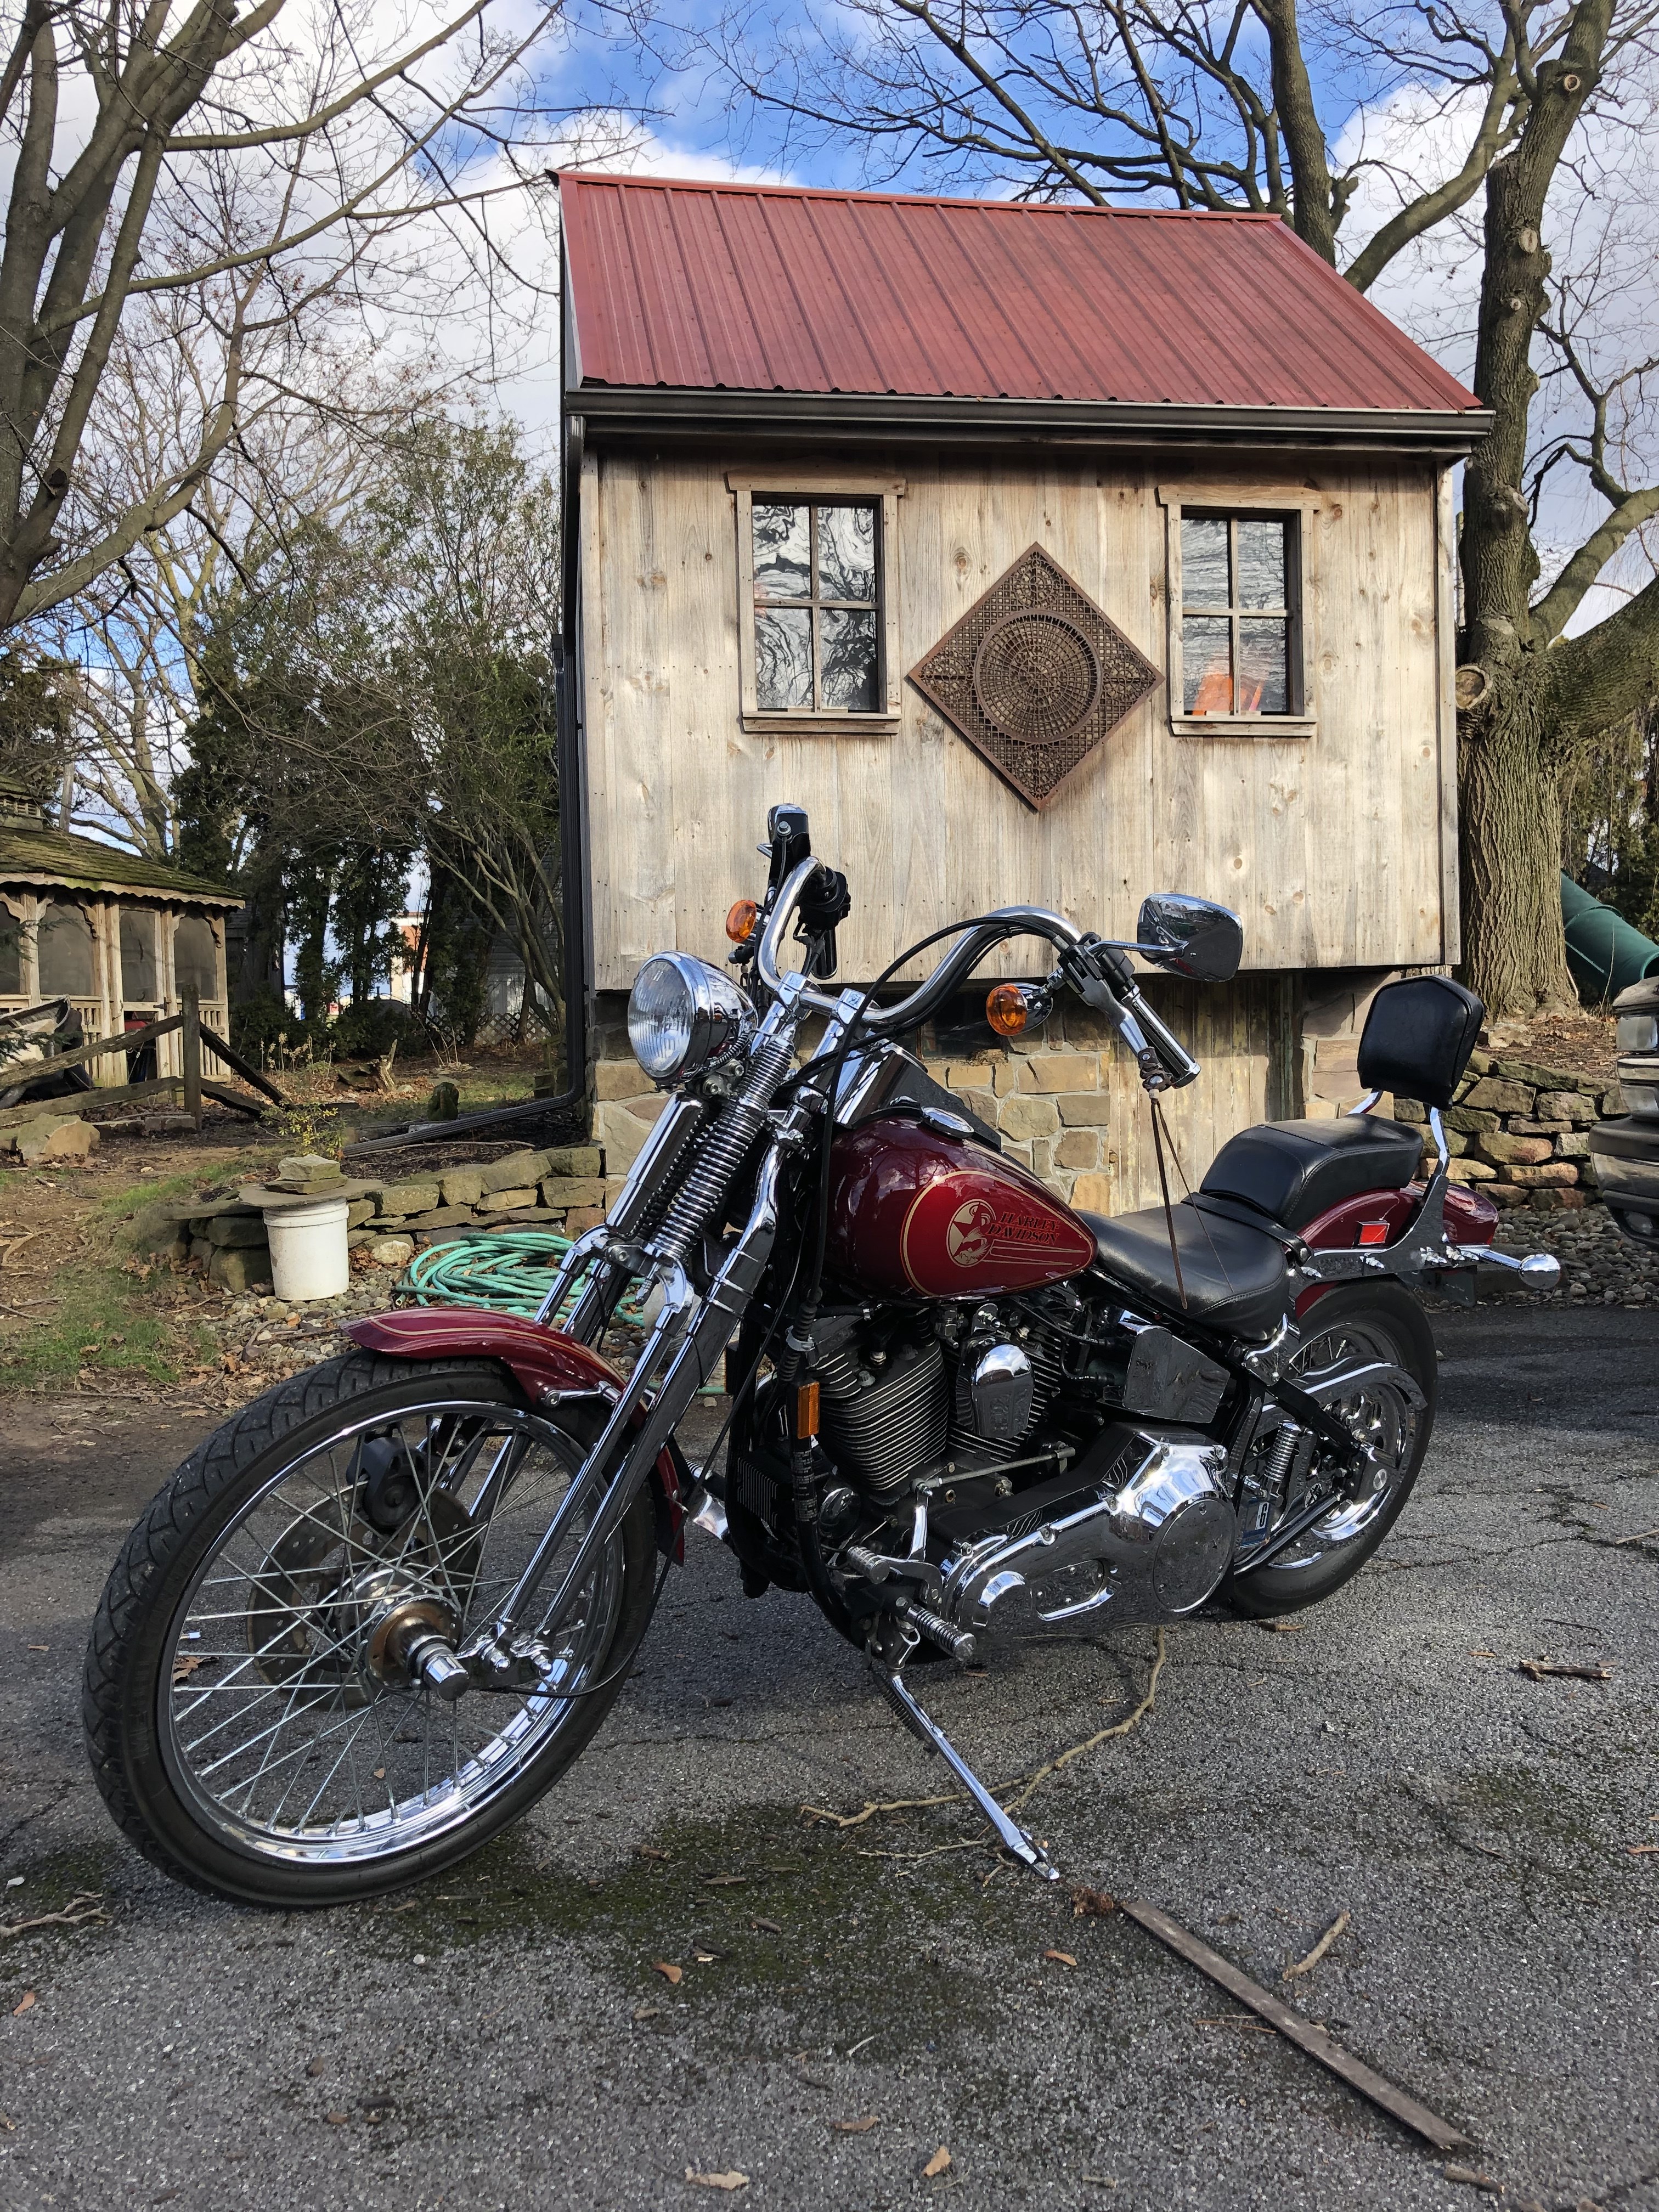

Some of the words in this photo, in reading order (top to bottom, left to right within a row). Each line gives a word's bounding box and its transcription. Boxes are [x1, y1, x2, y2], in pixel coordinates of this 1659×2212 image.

[998, 1211, 1060, 1232] HARLEY
[985, 1223, 1060, 1245] DAVIDSON
[1259, 1503, 1268, 1527] 6
